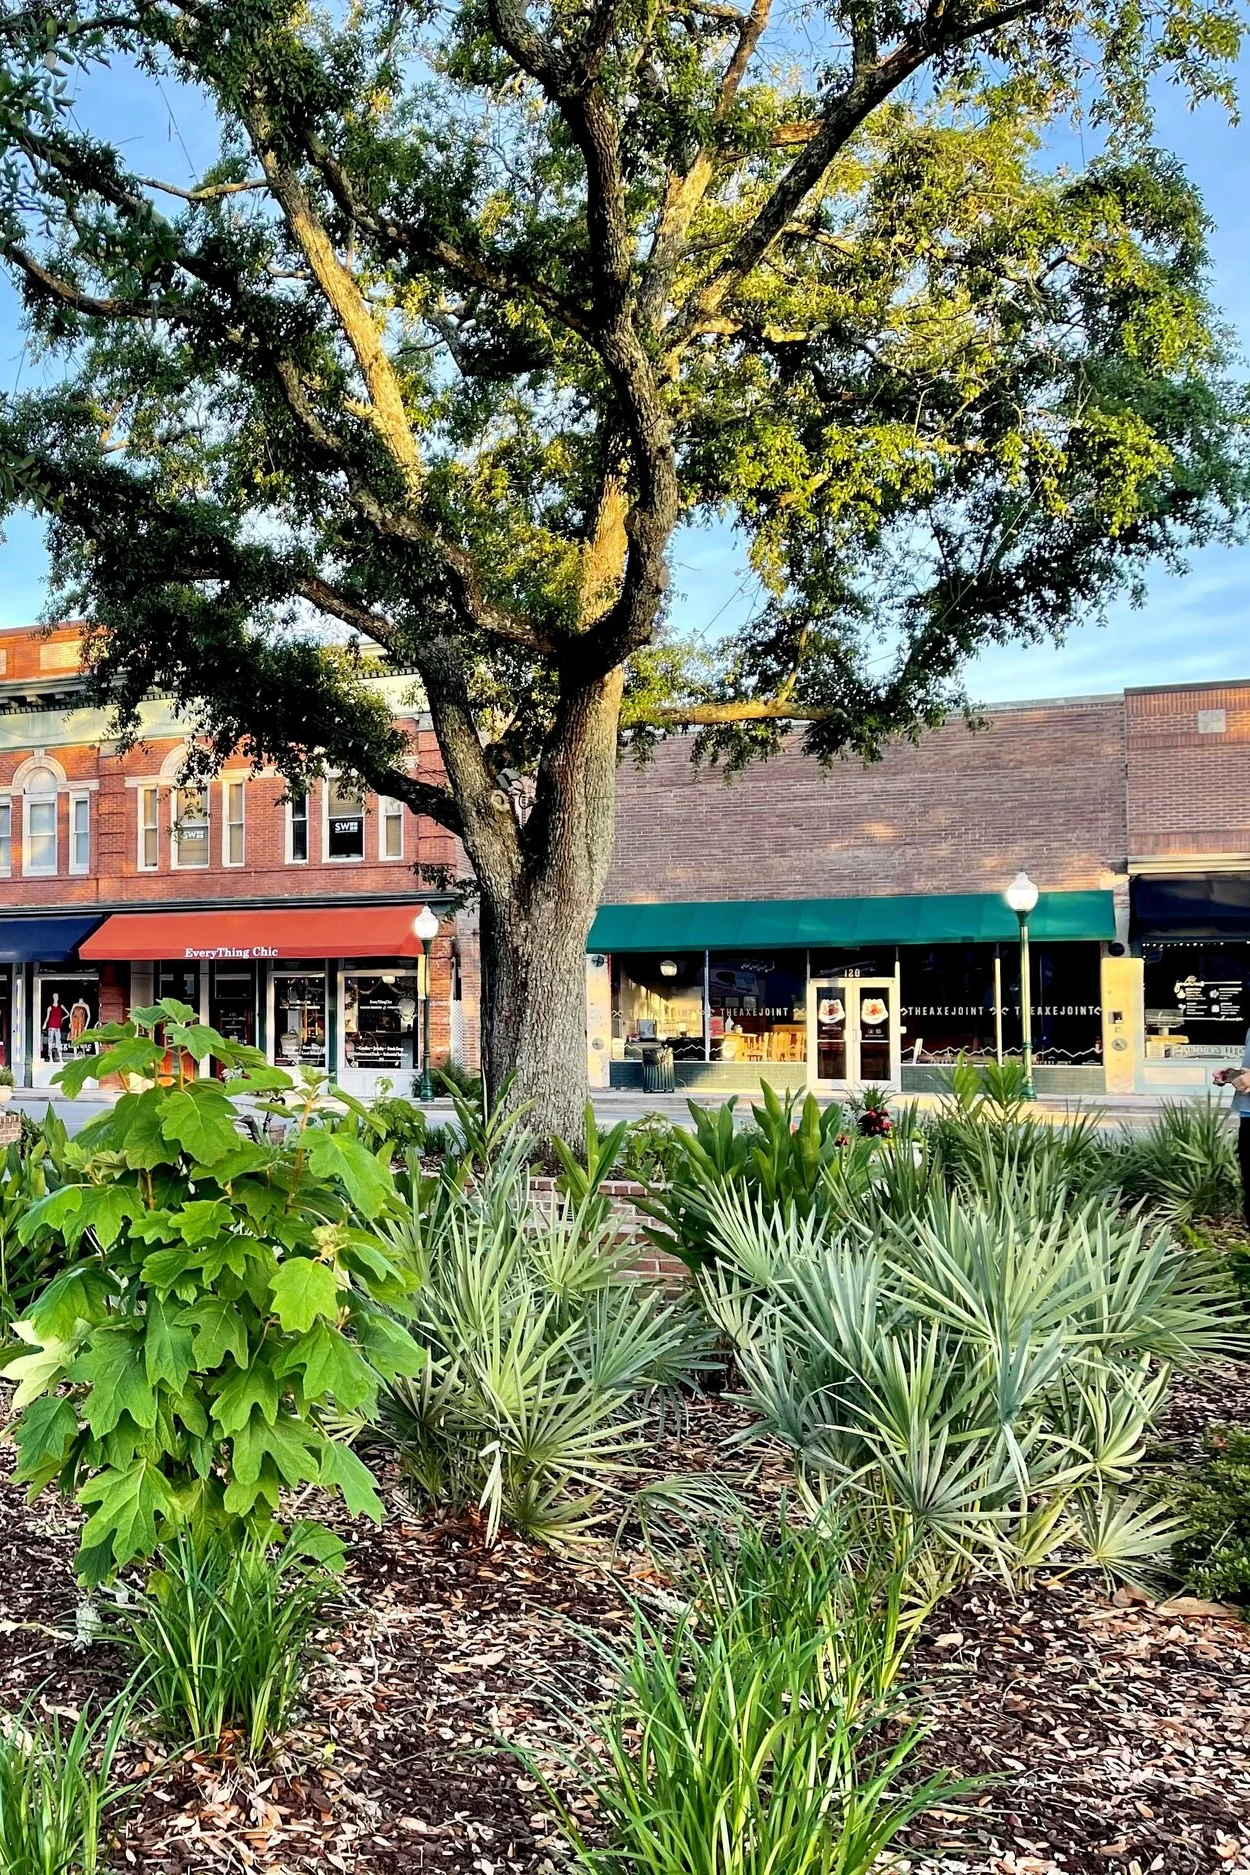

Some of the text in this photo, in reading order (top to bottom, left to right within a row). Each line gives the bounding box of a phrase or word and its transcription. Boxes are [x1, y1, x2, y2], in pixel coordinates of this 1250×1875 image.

[185, 946, 279, 959] EveryThing Chic
[844, 968, 860, 977] 120
